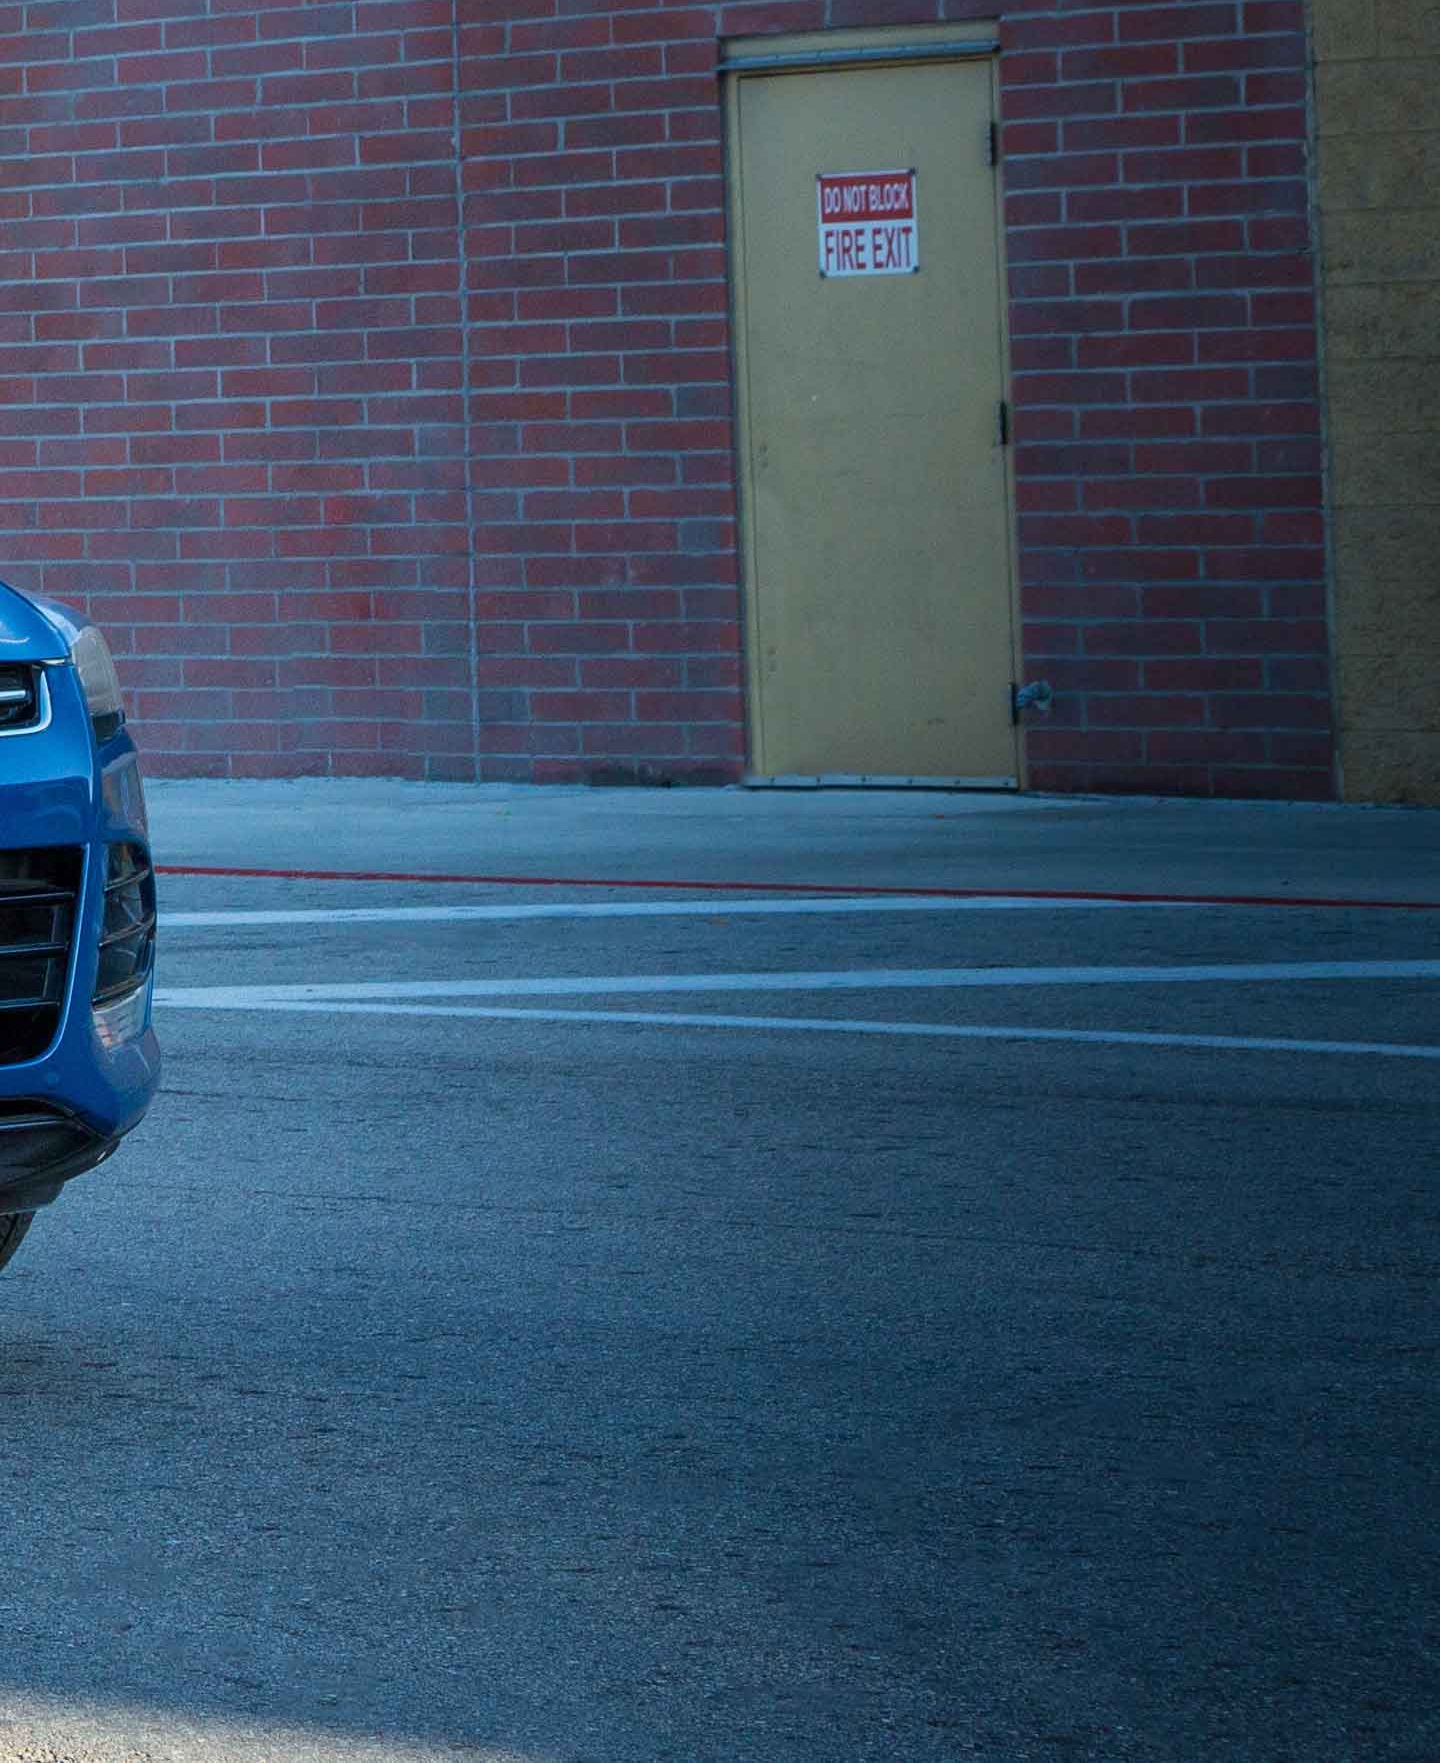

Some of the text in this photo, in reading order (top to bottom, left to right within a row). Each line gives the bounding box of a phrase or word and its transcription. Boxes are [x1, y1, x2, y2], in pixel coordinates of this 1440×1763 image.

[824, 183, 909, 214] DO NOT BLOCK
[825, 226, 912, 270] FIRE EXIT
